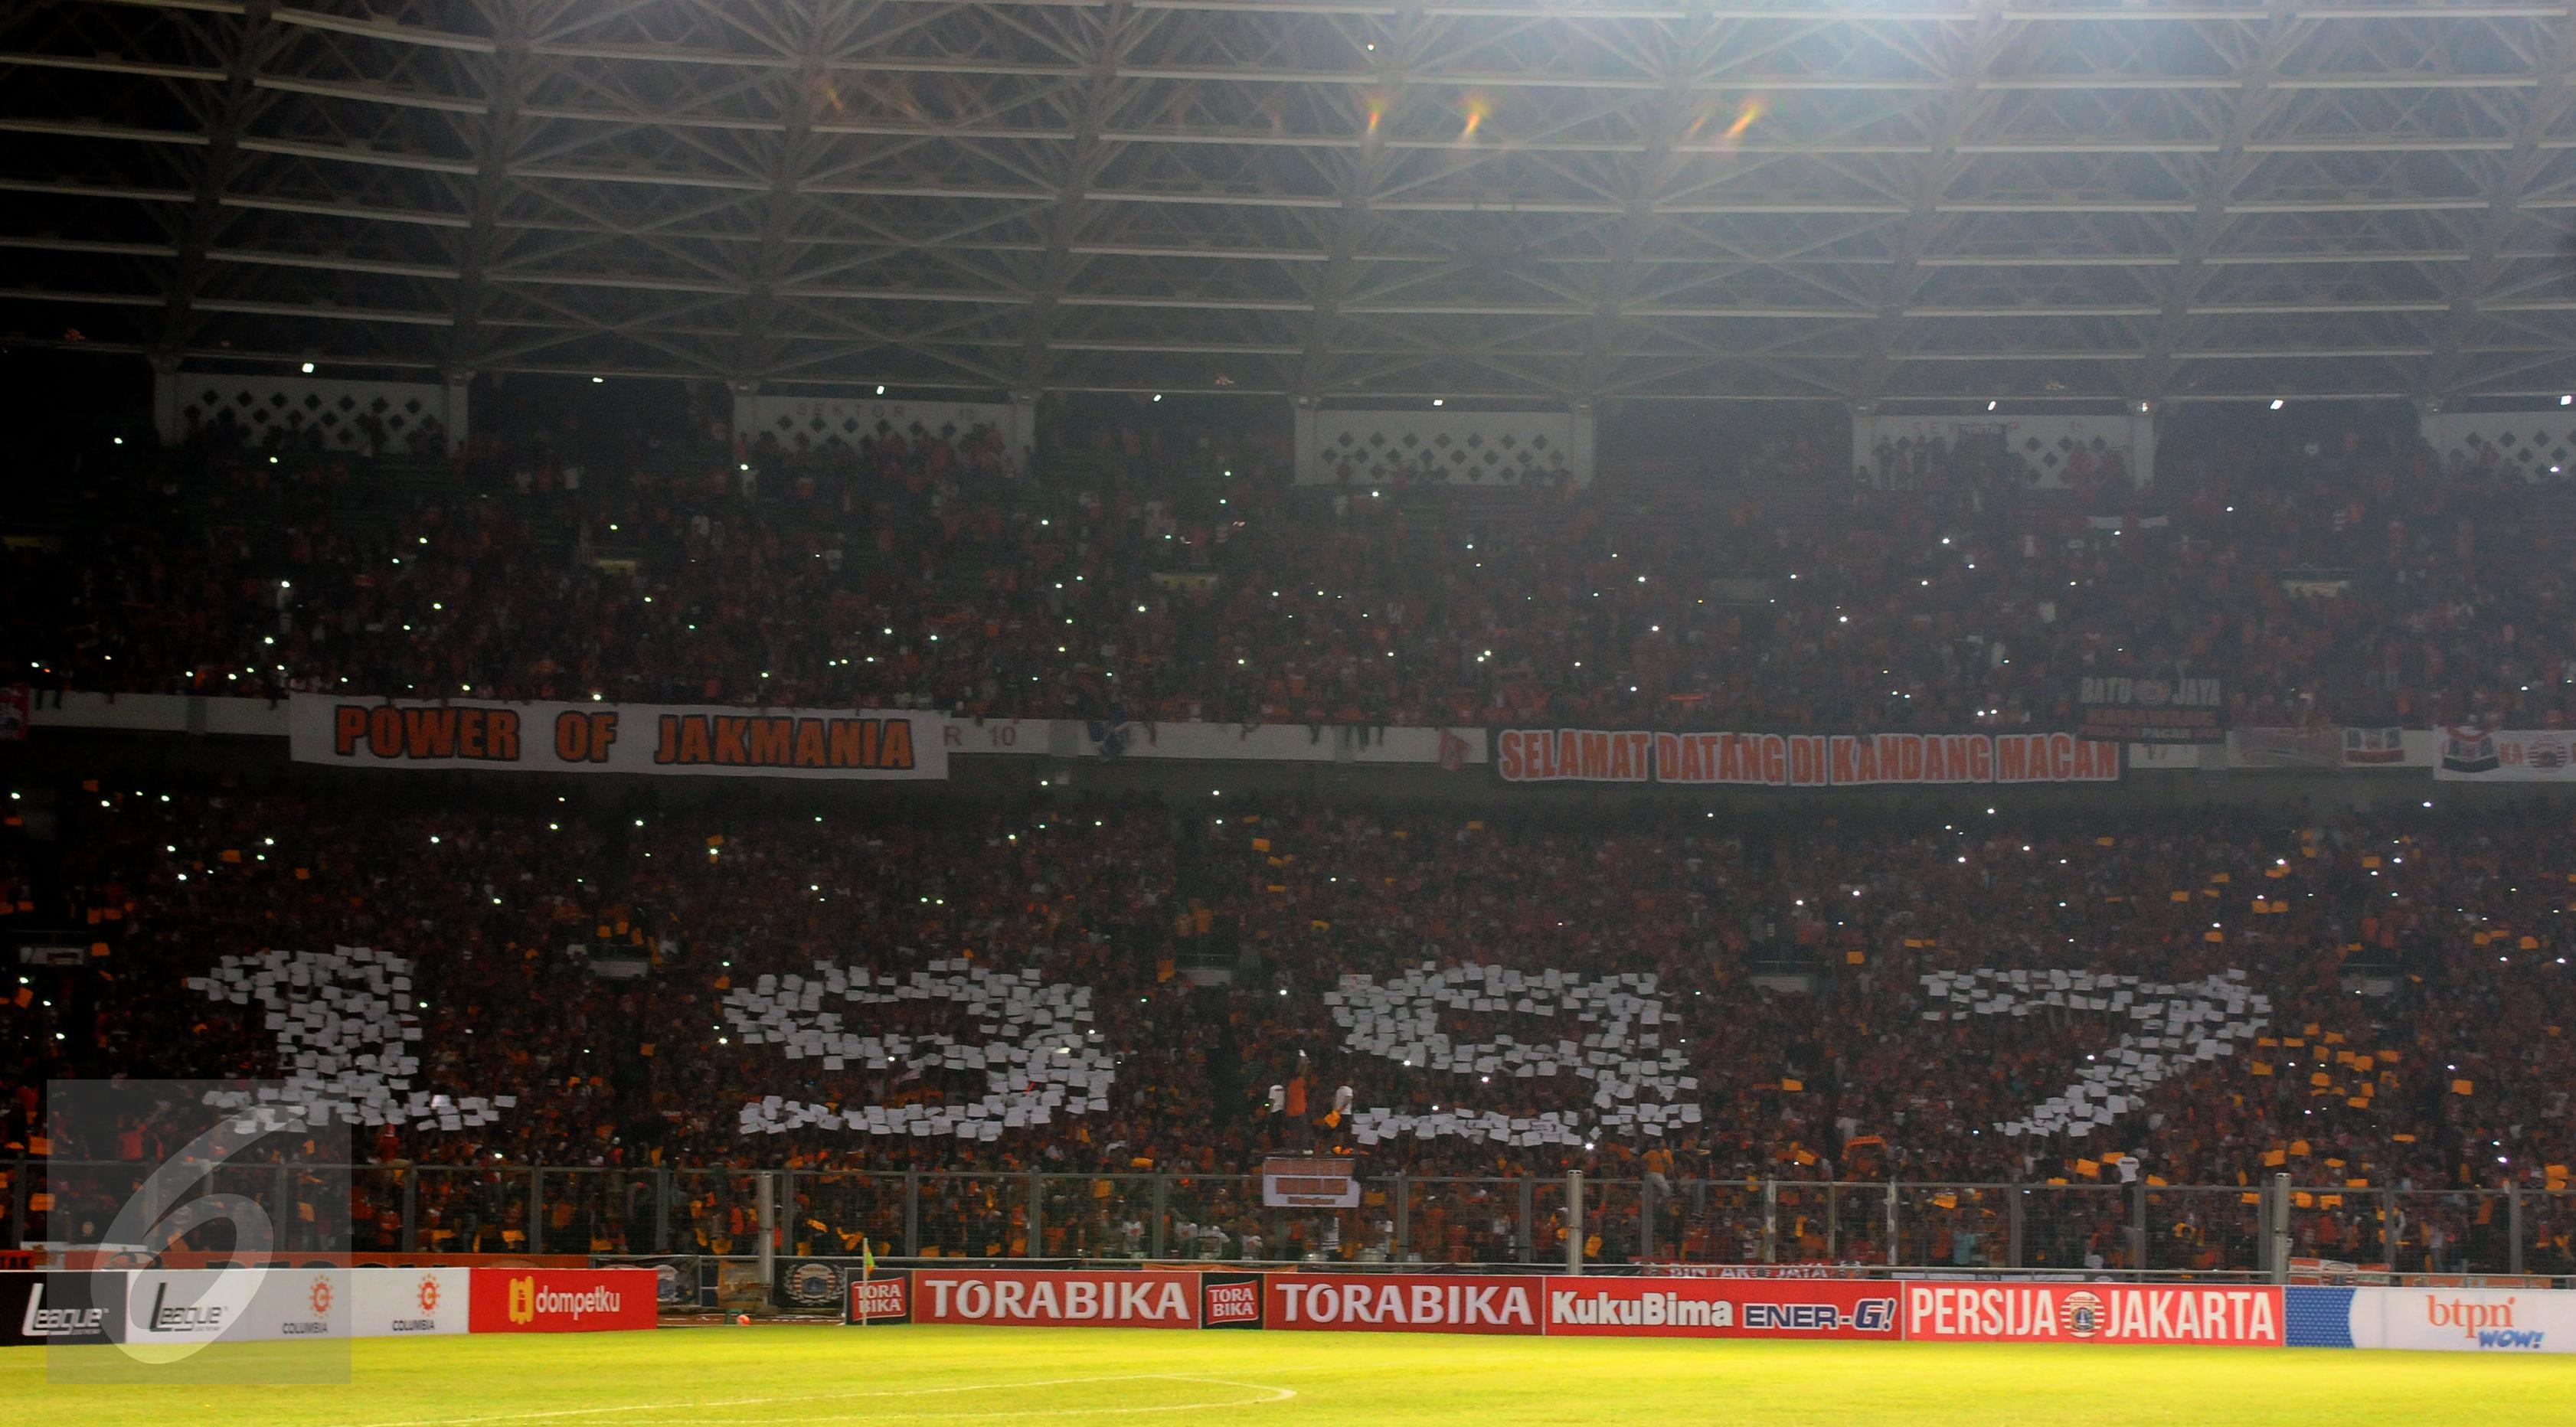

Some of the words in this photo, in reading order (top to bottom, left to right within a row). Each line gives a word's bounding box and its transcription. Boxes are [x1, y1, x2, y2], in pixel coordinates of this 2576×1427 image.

[335, 704, 520, 761] POWER
[554, 710, 619, 762] OF
[653, 714, 915, 770] JAKMANIA
[1498, 728, 1652, 782] SELAMAT
[1656, 732, 1786, 786] DATANG
[1788, 734, 1828, 787] DI
[1830, 733, 1993, 786] KANDANG
[1996, 732, 2120, 782] MACAN
[535, 1285, 621, 1315] dompetku
[854, 1284, 902, 1299] TORA
[858, 1298, 902, 1313] BIKA
[924, 1278, 1191, 1320] TORABIKA
[1210, 1286, 1256, 1303] TORA
[1274, 1282, 1535, 1326] TORABIKA
[1212, 1301, 1256, 1318] BIKA
[1551, 1290, 1734, 1327] KukuBima
[1743, 1297, 1898, 1334] ENER-G!
[1911, 1288, 2059, 1337] PERSIJA
[2104, 1289, 2276, 1340] JAKARTA
[2426, 1295, 2516, 1338] btpn
[282, 1322, 329, 1334] COLUMBIA
[392, 1319, 436, 1331] COLUMBIA
[2477, 1329, 2545, 1349] WOW!
